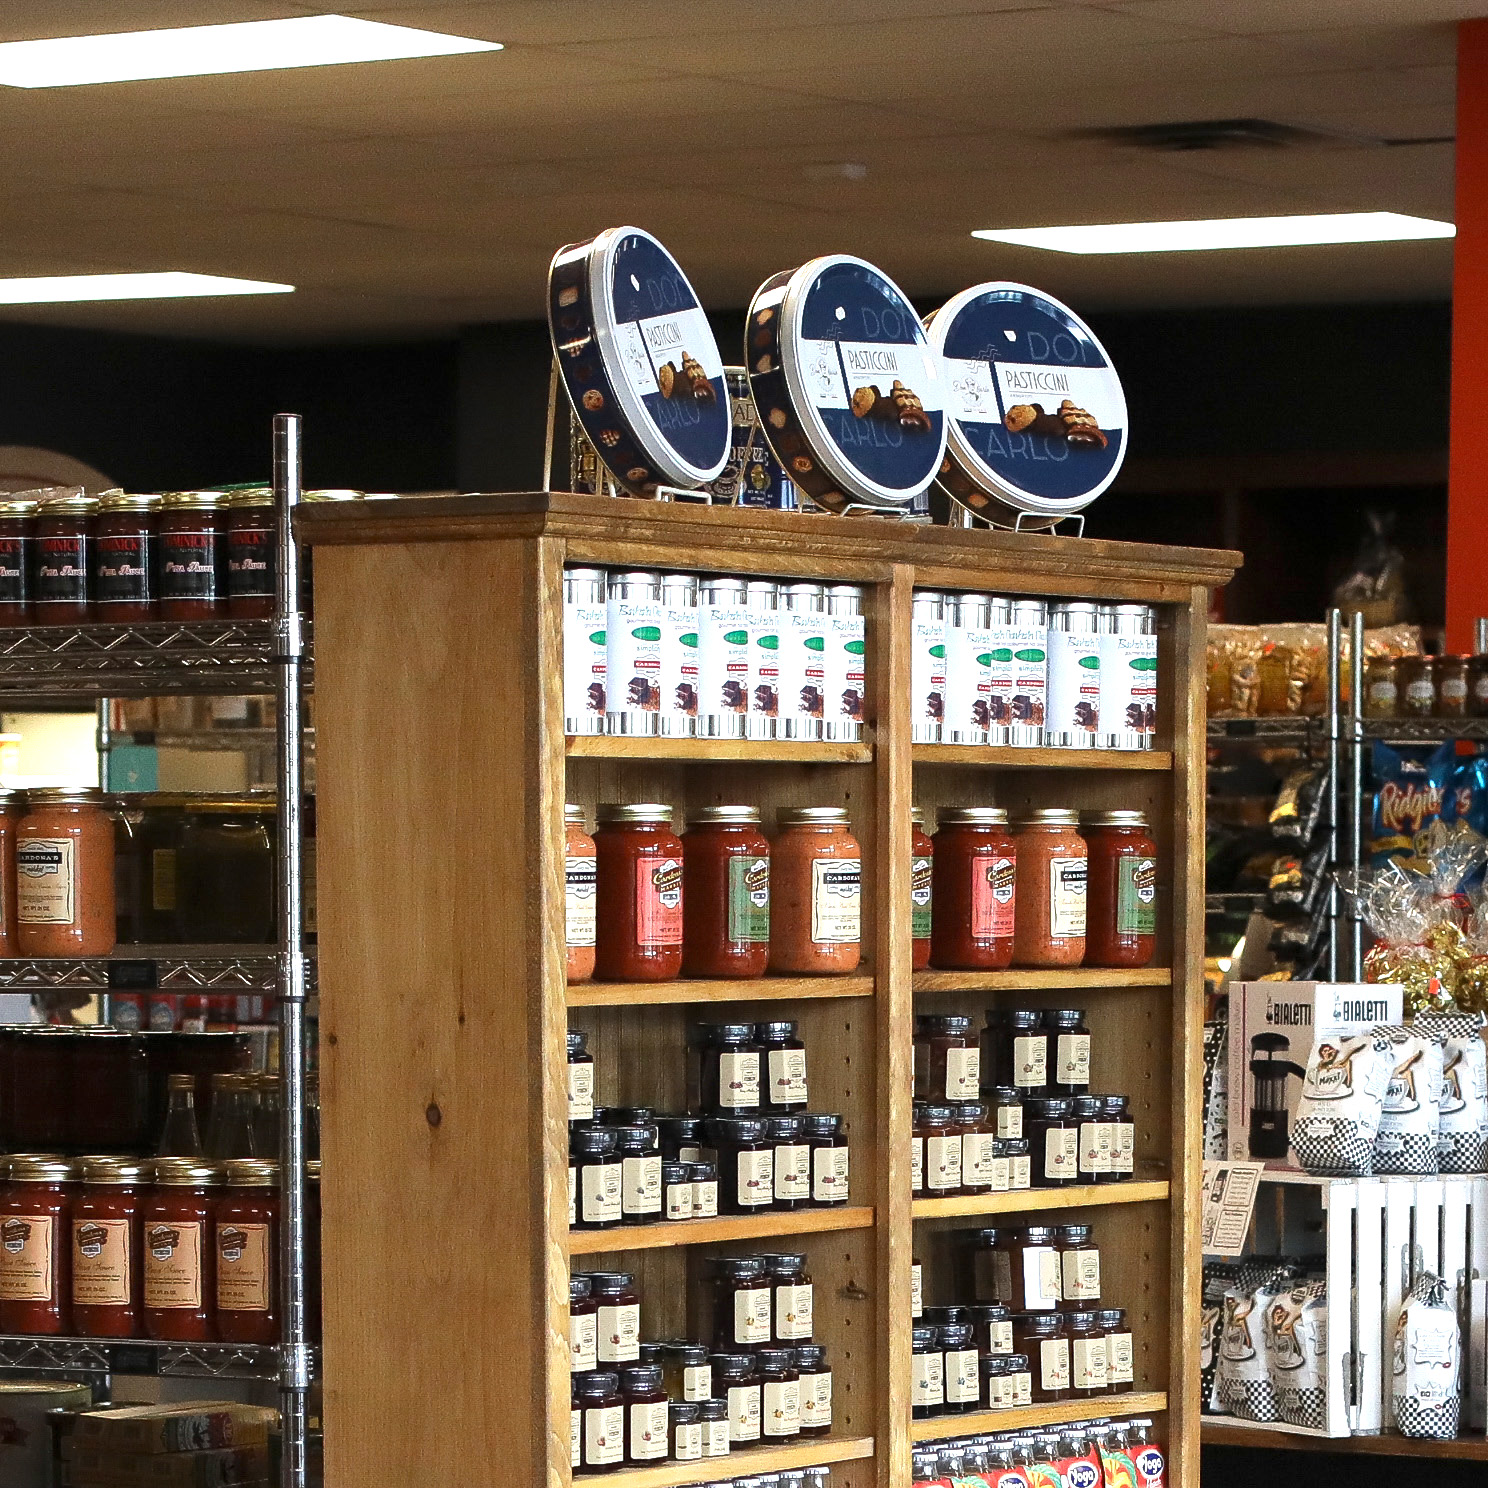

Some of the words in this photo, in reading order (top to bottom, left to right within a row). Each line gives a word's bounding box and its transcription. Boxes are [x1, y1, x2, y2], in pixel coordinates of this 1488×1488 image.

[646, 321, 683, 348] PASTICCINI
[847, 349, 899, 372] PASTICCINI
[1005, 370, 1071, 393] PASTICCINI
[964, 427, 1069, 462] CARLO
[1273, 1002, 1312, 1026] BIALETTI
[1342, 1000, 1388, 1022] BIALETTI
[1232, 1038, 1241, 1070] coffee
[1141, 1454, 1164, 1473] Yoga
[1070, 1467, 1097, 1487] Yoga
